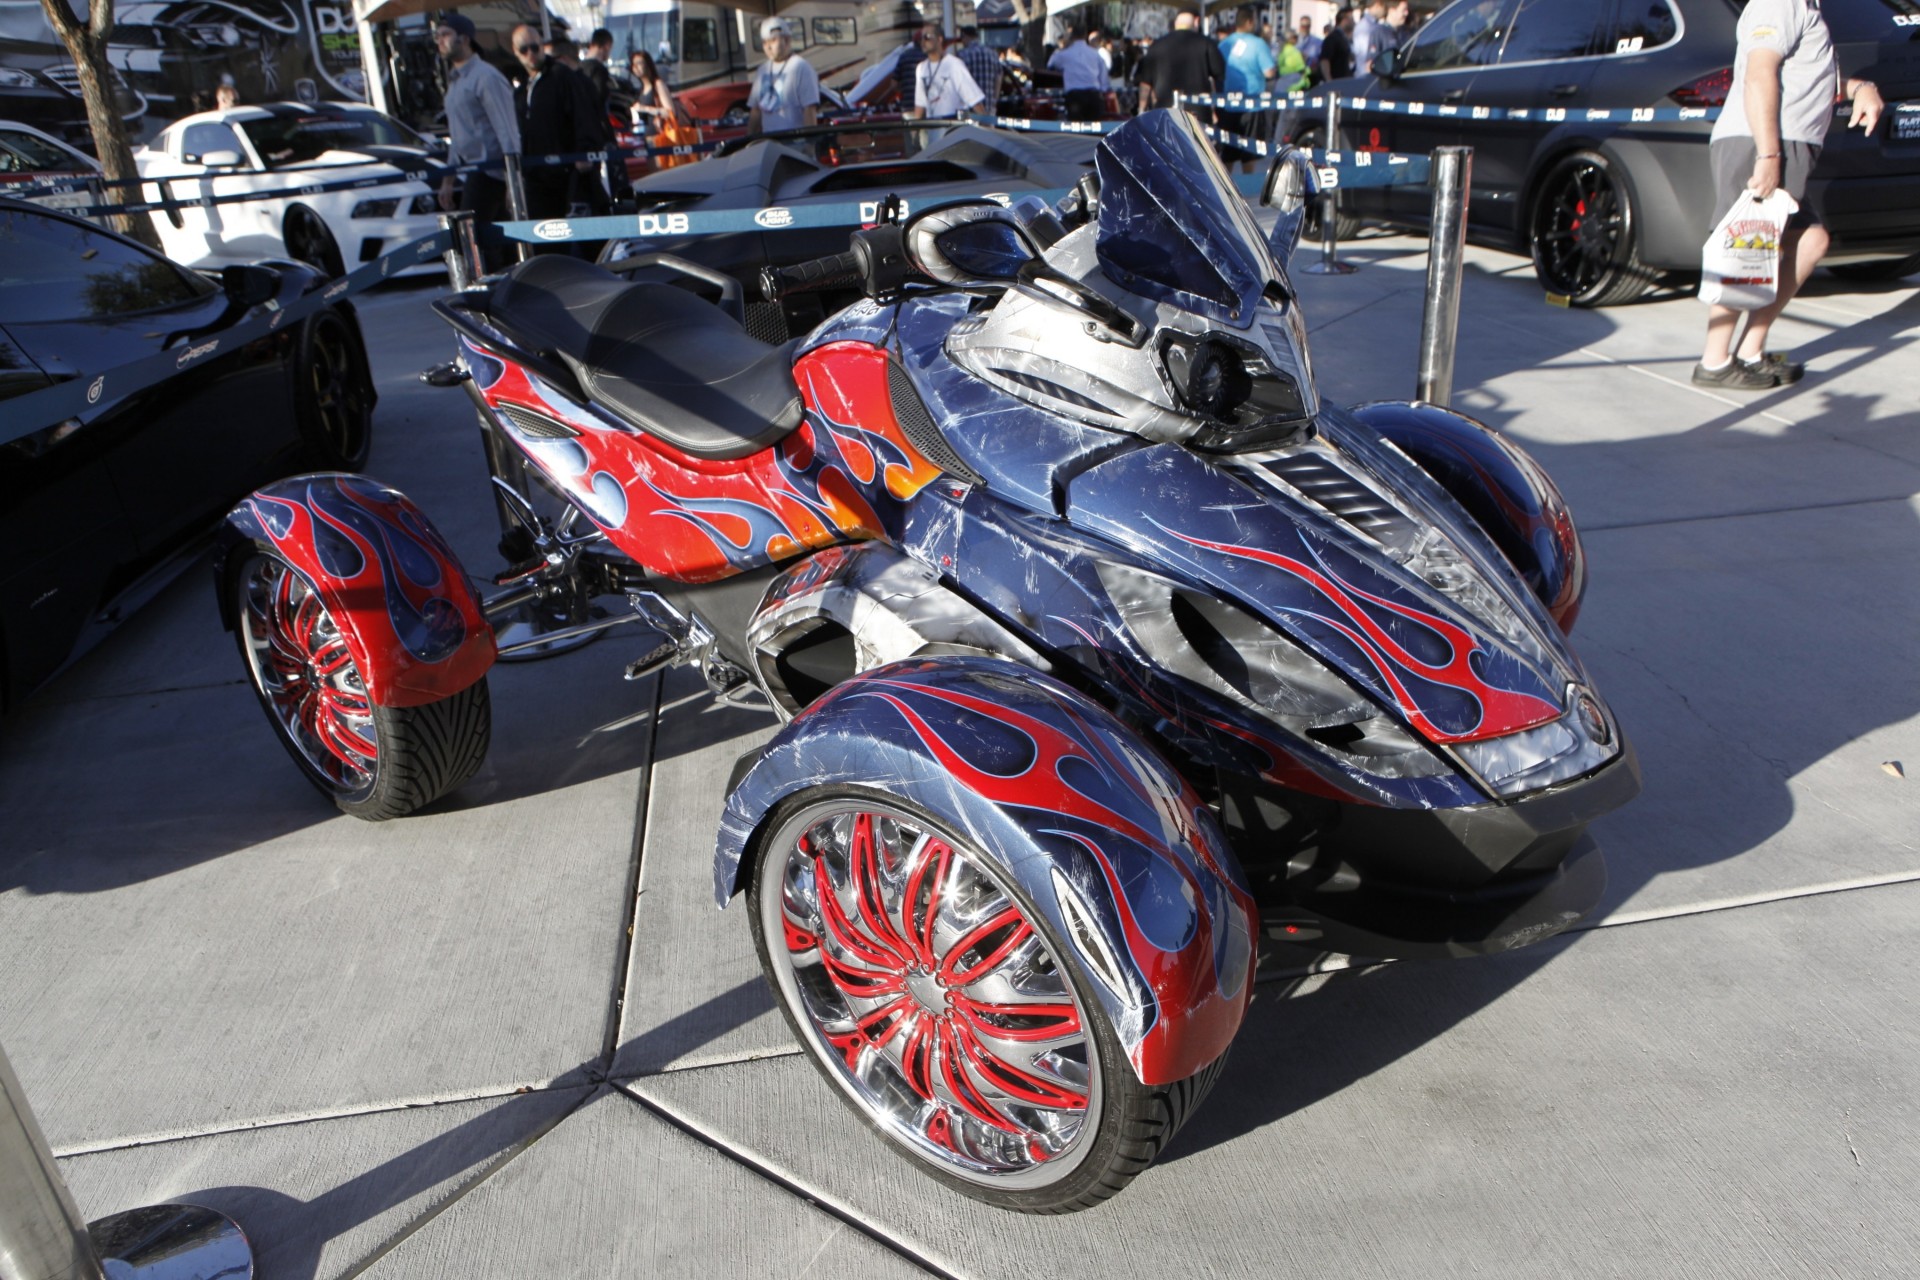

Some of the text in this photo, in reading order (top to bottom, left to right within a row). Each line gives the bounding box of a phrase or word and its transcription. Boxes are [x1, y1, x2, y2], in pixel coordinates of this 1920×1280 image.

[316, 7, 360, 33] DU
[765, 210, 789, 218] BUD
[860, 199, 910, 223] DB
[639, 213, 689, 235] DUB
[760, 216, 793, 225] LIGHT
[544, 222, 568, 230] BUD
[539, 229, 572, 237] LIGHT
